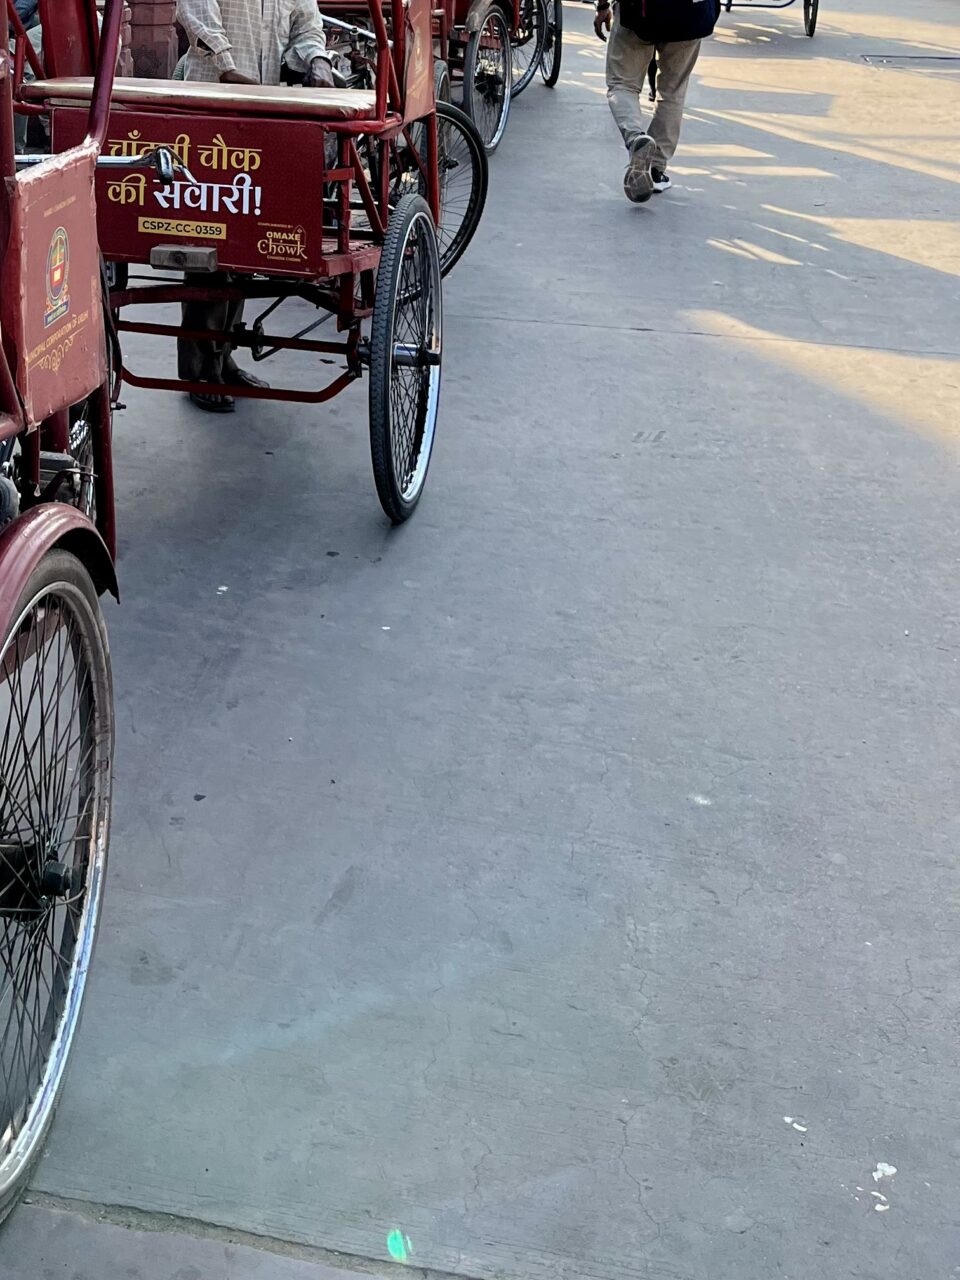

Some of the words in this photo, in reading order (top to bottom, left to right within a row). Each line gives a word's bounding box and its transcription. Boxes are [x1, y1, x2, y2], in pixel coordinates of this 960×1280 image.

[197, 133, 262, 172] चौक
[106, 173, 147, 206] की
[152, 173, 262, 216] सवारी!
[142, 220, 223, 237] CSPZ-CC-0359
[266, 231, 301, 241] OMAXE
[257, 238, 308, 259] Chowk
